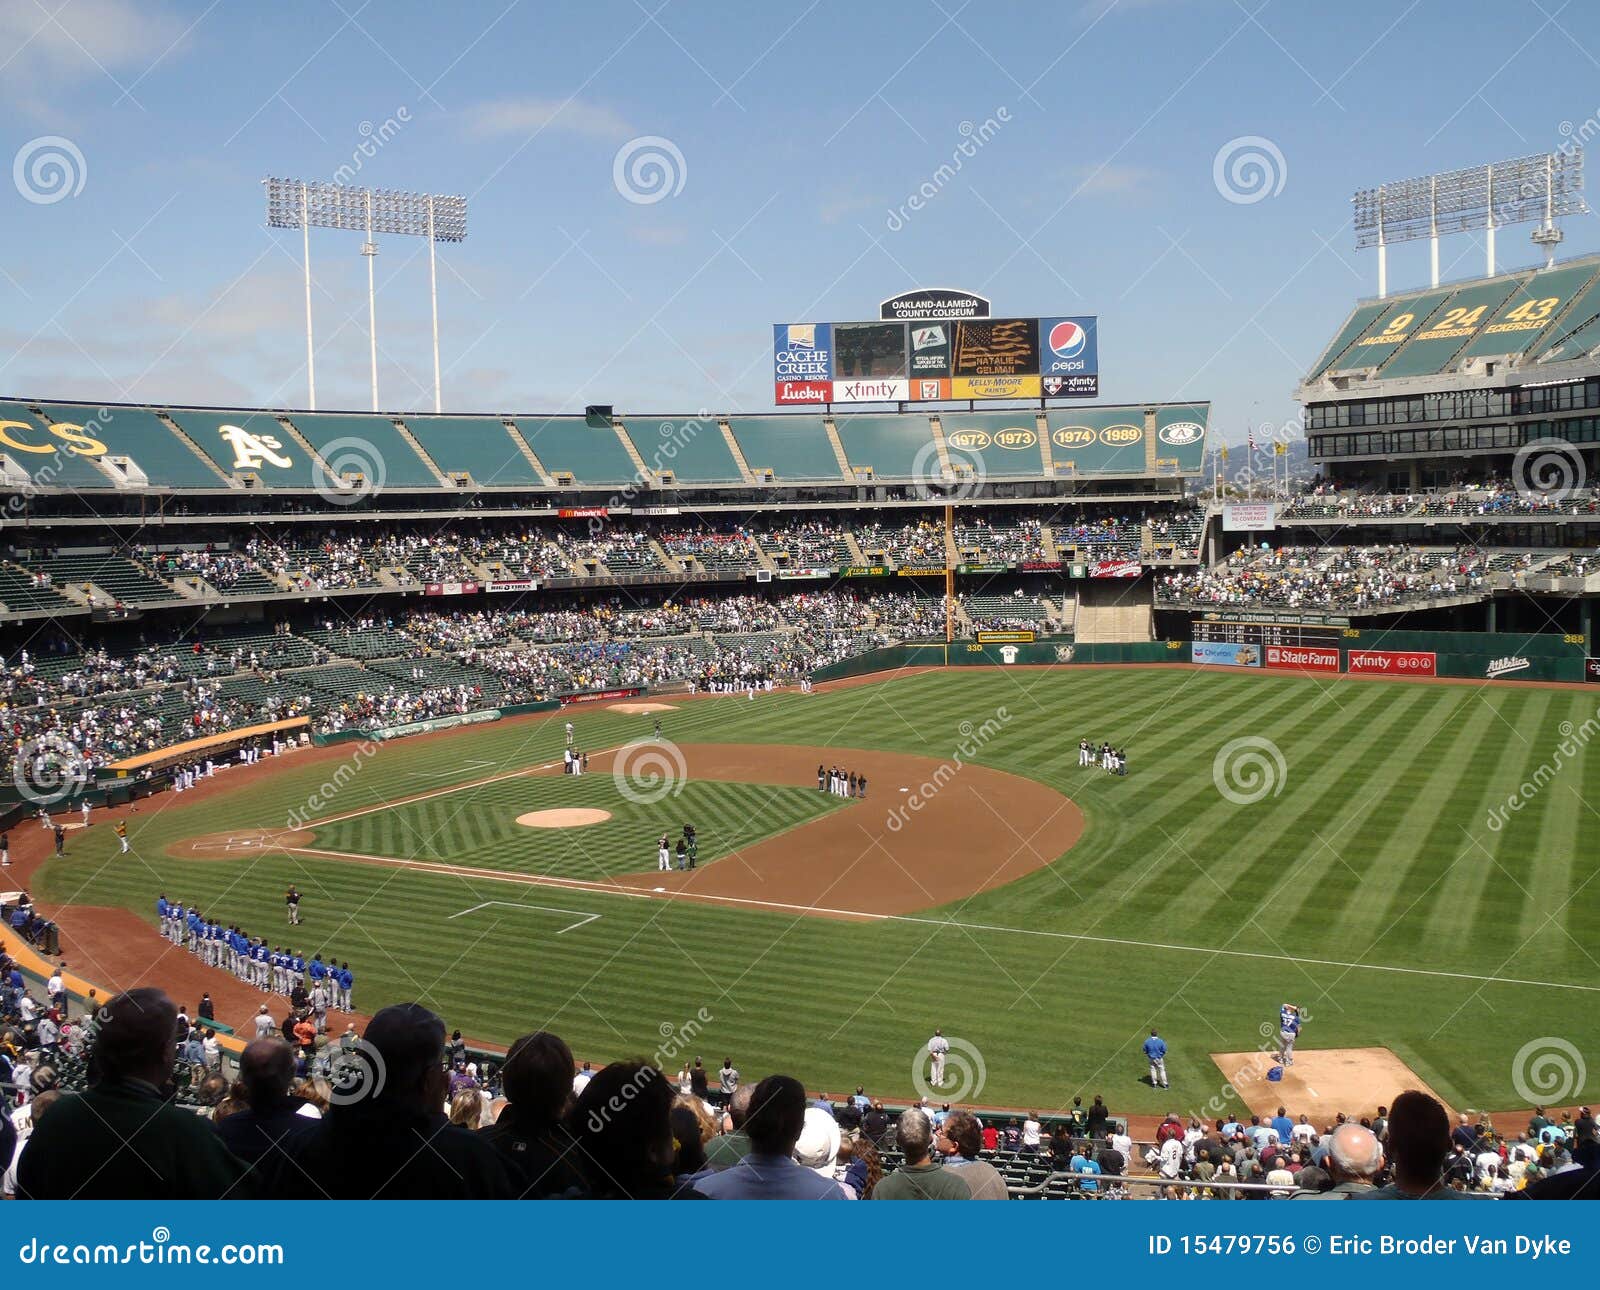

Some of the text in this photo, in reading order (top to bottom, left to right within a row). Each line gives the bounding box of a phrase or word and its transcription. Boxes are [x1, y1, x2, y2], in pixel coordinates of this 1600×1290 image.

[892, 300, 978, 309] OAKLAND-ALAMEDA
[1505, 297, 1559, 321] 43
[896, 308, 975, 318] COUNTY COLISEUM
[1433, 305, 1488, 330] 24
[1383, 313, 1414, 335] 9
[1485, 319, 1550, 334] ECKERSLEY
[1359, 333, 1408, 346] JACKSON
[1415, 326, 1479, 341] HENDERSON
[776, 351, 828, 362] CACHE
[976, 356, 1015, 365] NATALIE
[776, 362, 828, 374] CREEK
[976, 366, 1015, 374] GELMAN
[1052, 360, 1085, 372] pepsi
[968, 378, 1023, 387] KELLY-MOORE
[1069, 377, 1096, 387] xfinity
[781, 383, 824, 402] Lucky
[845, 382, 897, 400] xfinity
[953, 433, 987, 446] 1972
[998, 432, 1031, 445] 1973
[1058, 430, 1091, 443] 1974
[1105, 429, 1138, 441] 1989
[1090, 561, 1139, 577] Budweiser
[644, 573, 719, 583] ANDERSON
[1564, 634, 1584, 644] 388
[967, 644, 982, 652] 330
[1205, 649, 1231, 658] Chevron
[1352, 655, 1391, 669] xfinity
[1486, 656, 1529, 674] Athletics
